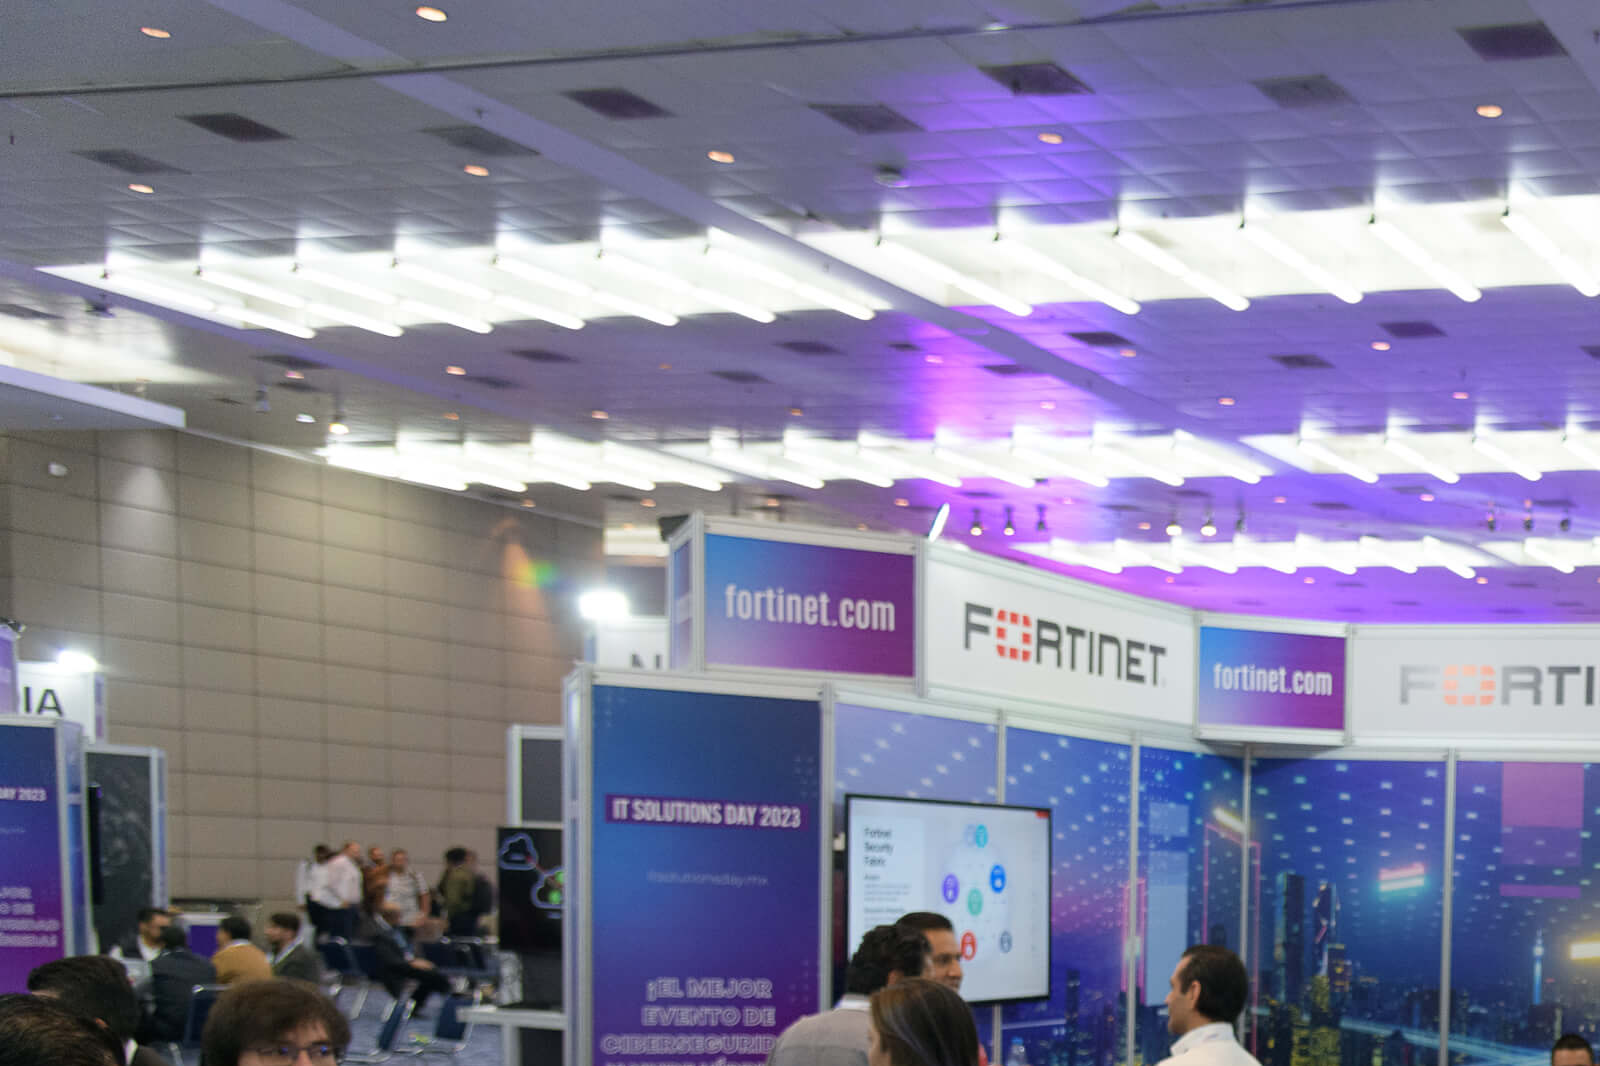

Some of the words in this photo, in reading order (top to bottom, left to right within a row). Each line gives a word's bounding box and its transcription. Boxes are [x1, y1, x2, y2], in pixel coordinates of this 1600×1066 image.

[725, 584, 896, 632] fortinet.com
[965, 602, 1167, 686] FORTINET
[1213, 662, 1333, 696] fortinet.com
[18, 788, 48, 801] 2023
[613, 798, 630, 820] IT
[632, 799, 722, 825] SOLUTIONS
[724, 804, 757, 826] DAY
[759, 805, 801, 828] 2023
[686, 977, 773, 999] MEJOR
[641, 1006, 740, 1026] EVENTO
[743, 1007, 776, 1027] DE
[602, 1034, 776, 1055] CIBERSEGURID
